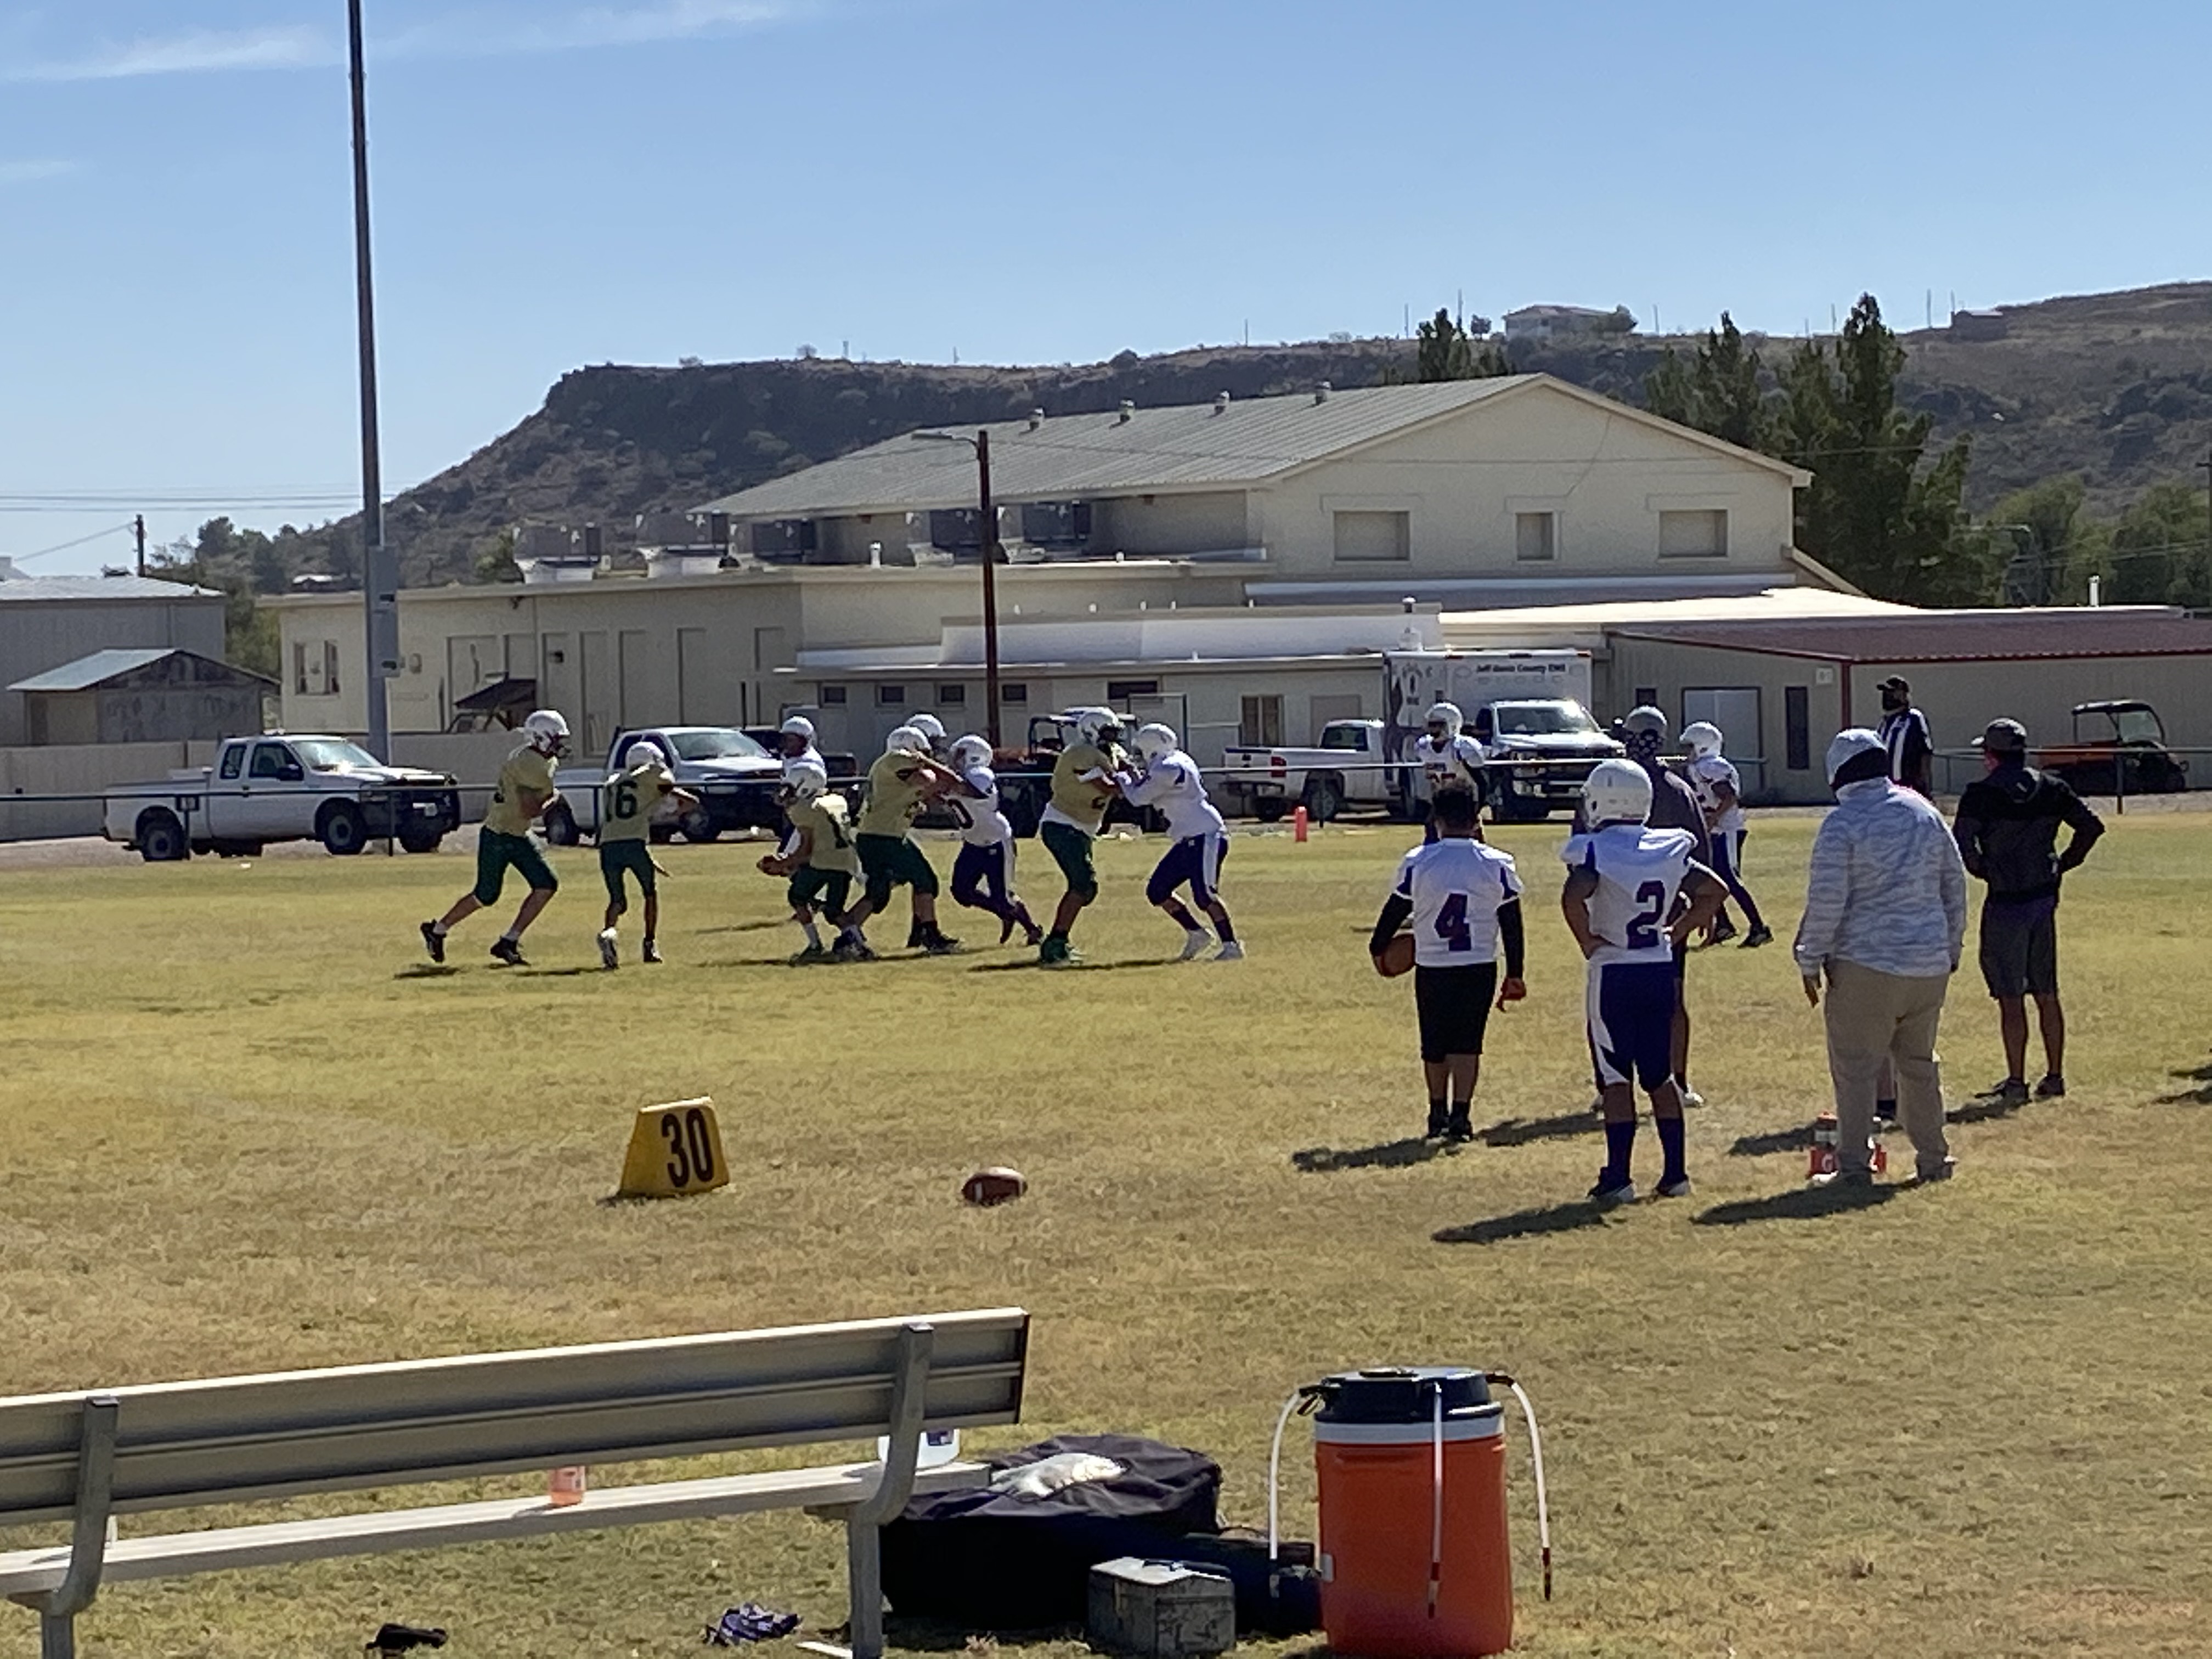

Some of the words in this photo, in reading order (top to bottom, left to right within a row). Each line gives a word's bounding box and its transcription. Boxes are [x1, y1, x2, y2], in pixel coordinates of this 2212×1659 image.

[1434, 893, 1471, 951] 4
[1626, 880, 1665, 950] 2
[662, 1108, 714, 1188] 30
